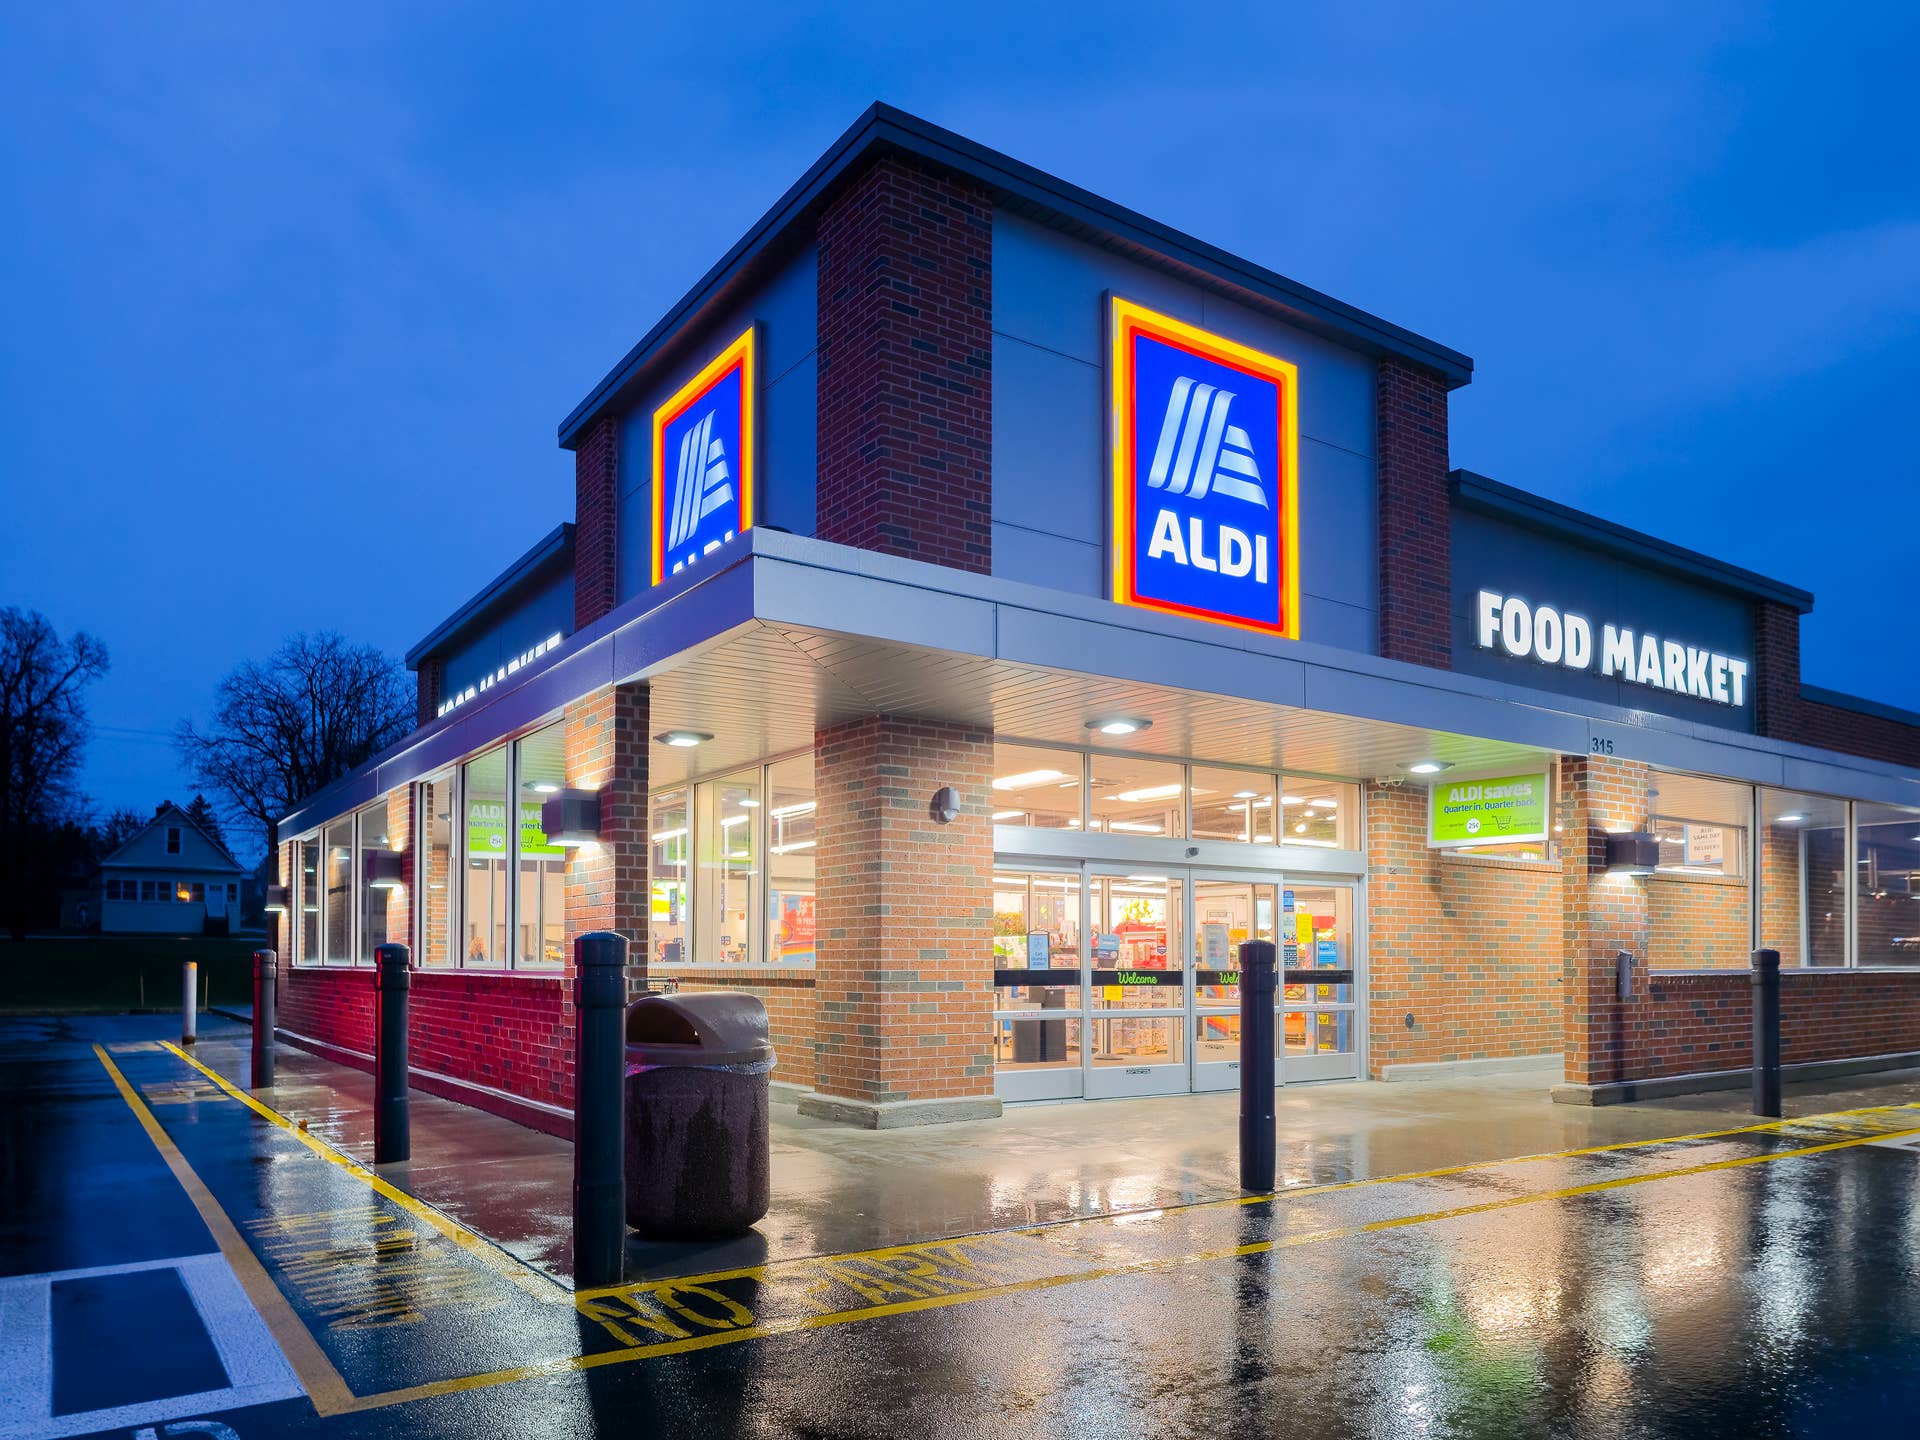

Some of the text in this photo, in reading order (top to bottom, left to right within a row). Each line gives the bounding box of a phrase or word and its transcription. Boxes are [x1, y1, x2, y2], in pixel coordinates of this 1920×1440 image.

[1147, 508, 1268, 584] ALDI
[1479, 590, 1748, 707] FOOD MARKET
[1592, 737, 1614, 755] 315
[1449, 783, 1533, 803] ALDI saves
[1443, 805, 1472, 814] Quarter
[1485, 801, 1514, 810] Quarter
[1118, 972, 1158, 984] Welcome
[577, 1283, 755, 1347] NO
